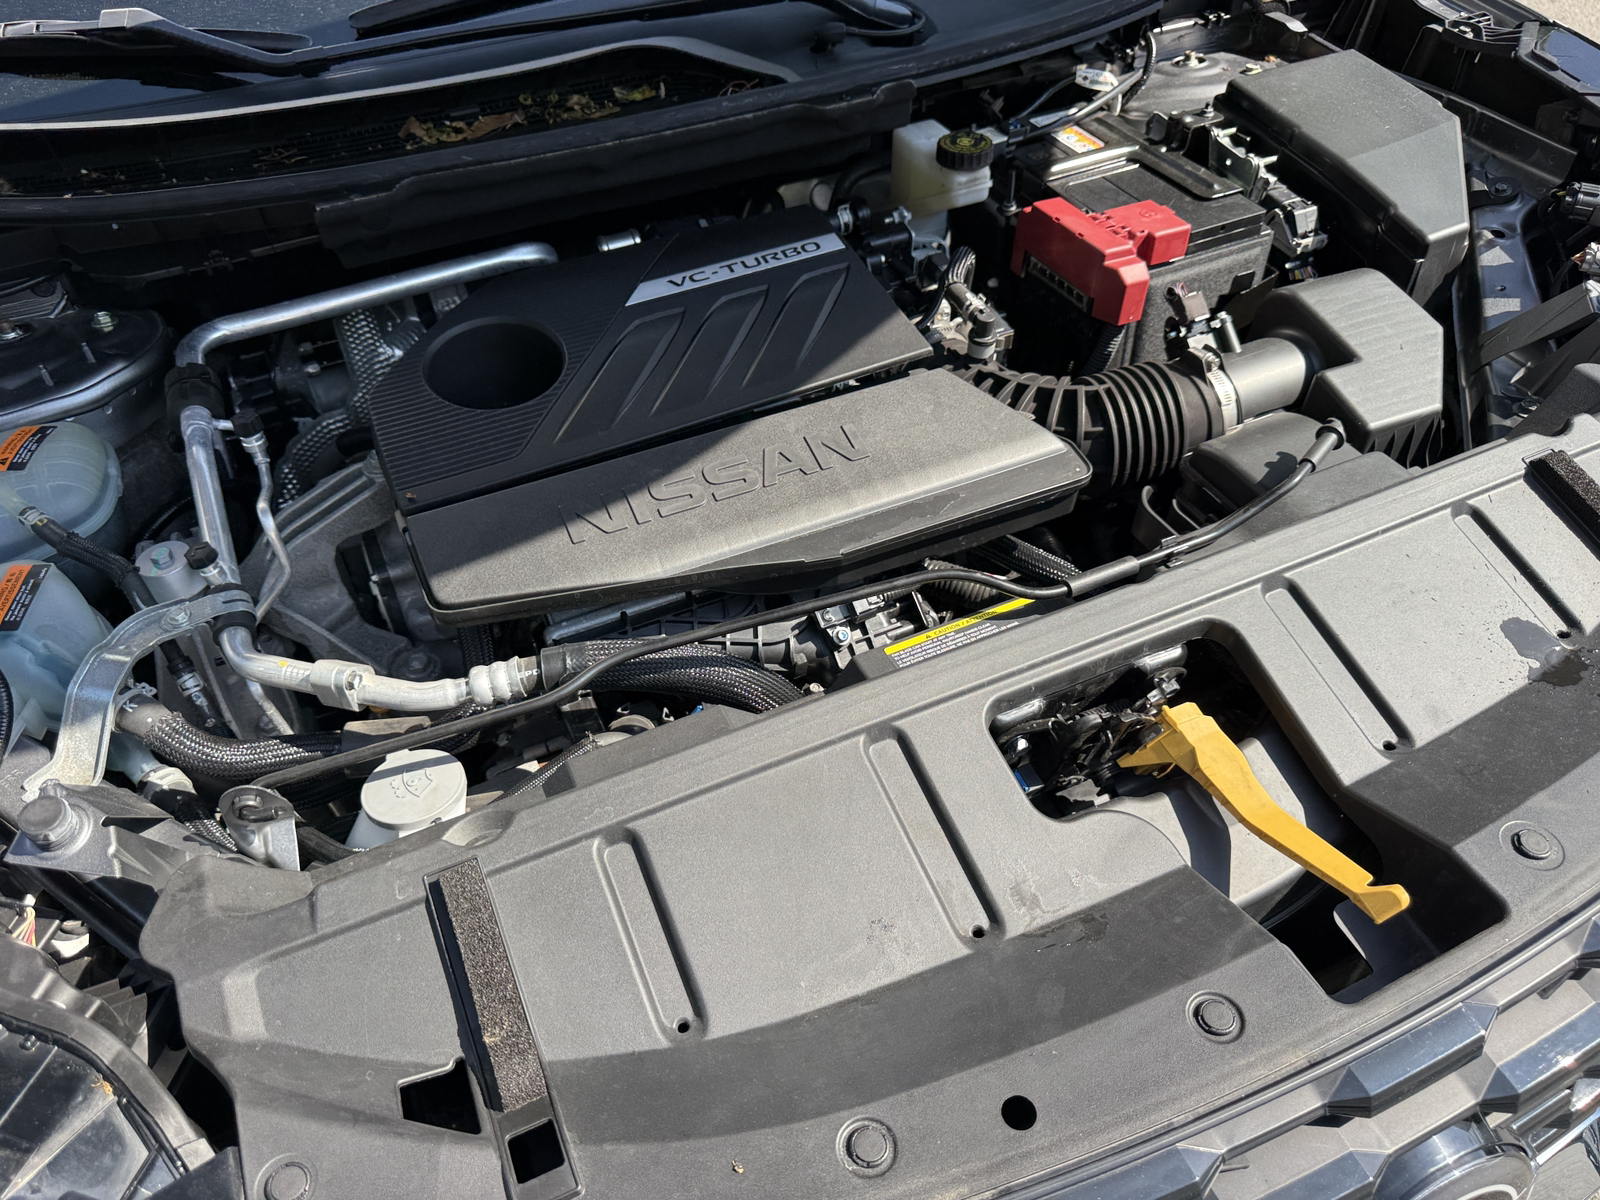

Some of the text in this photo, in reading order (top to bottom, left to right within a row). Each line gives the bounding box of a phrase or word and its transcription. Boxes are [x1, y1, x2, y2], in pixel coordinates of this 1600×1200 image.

[667, 241, 821, 288] VC-TURBO
[558, 422, 870, 545] NISSAN
[933, 623, 961, 636] CAUTION
[964, 610, 998, 624] ATTENTION
